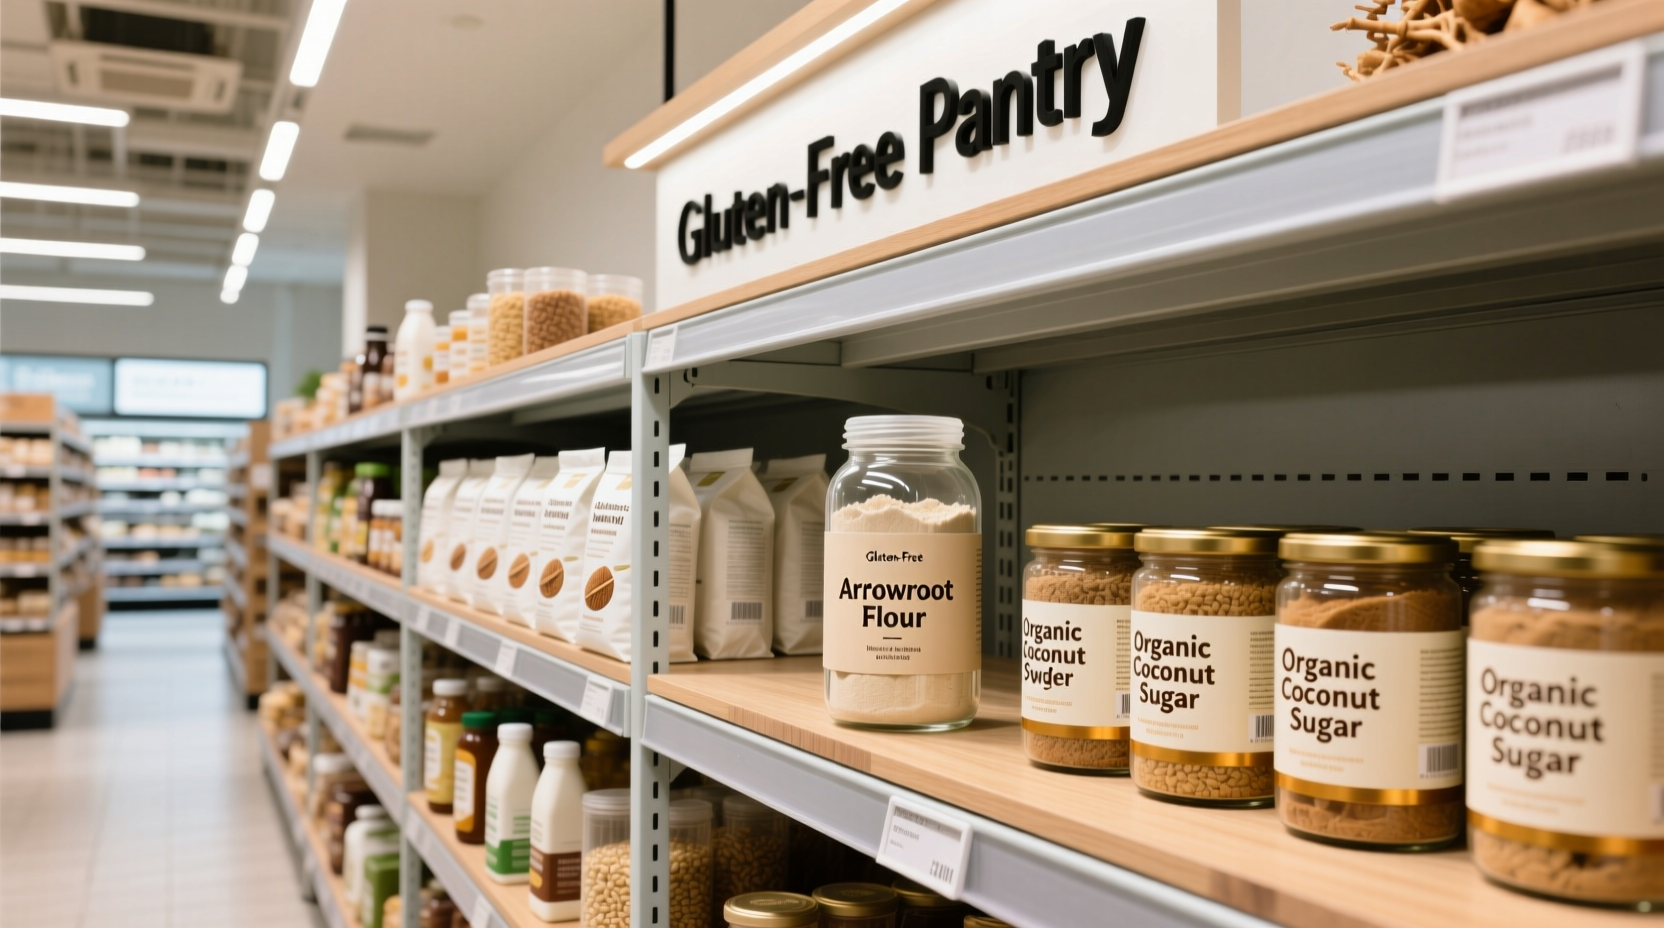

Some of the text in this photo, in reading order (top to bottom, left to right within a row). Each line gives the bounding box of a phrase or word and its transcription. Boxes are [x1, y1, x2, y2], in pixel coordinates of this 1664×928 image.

[678, 17, 1146, 265] Gluten-Free Pantry
[838, 577, 954, 601] Arrowroot
[862, 605, 927, 628] Flour
[1023, 617, 1082, 645] Organic
[1133, 630, 1211, 661] Organic
[1133, 655, 1216, 686] Coconut
[1282, 647, 1376, 683] Organic
[1139, 681, 1200, 714] Sugar
[1281, 676, 1380, 711] Coconut
[1480, 667, 1599, 709] Organic
[1290, 706, 1363, 743] Sugar
[1479, 700, 1606, 743] Coconut
[1491, 735, 1582, 781] Sugar
